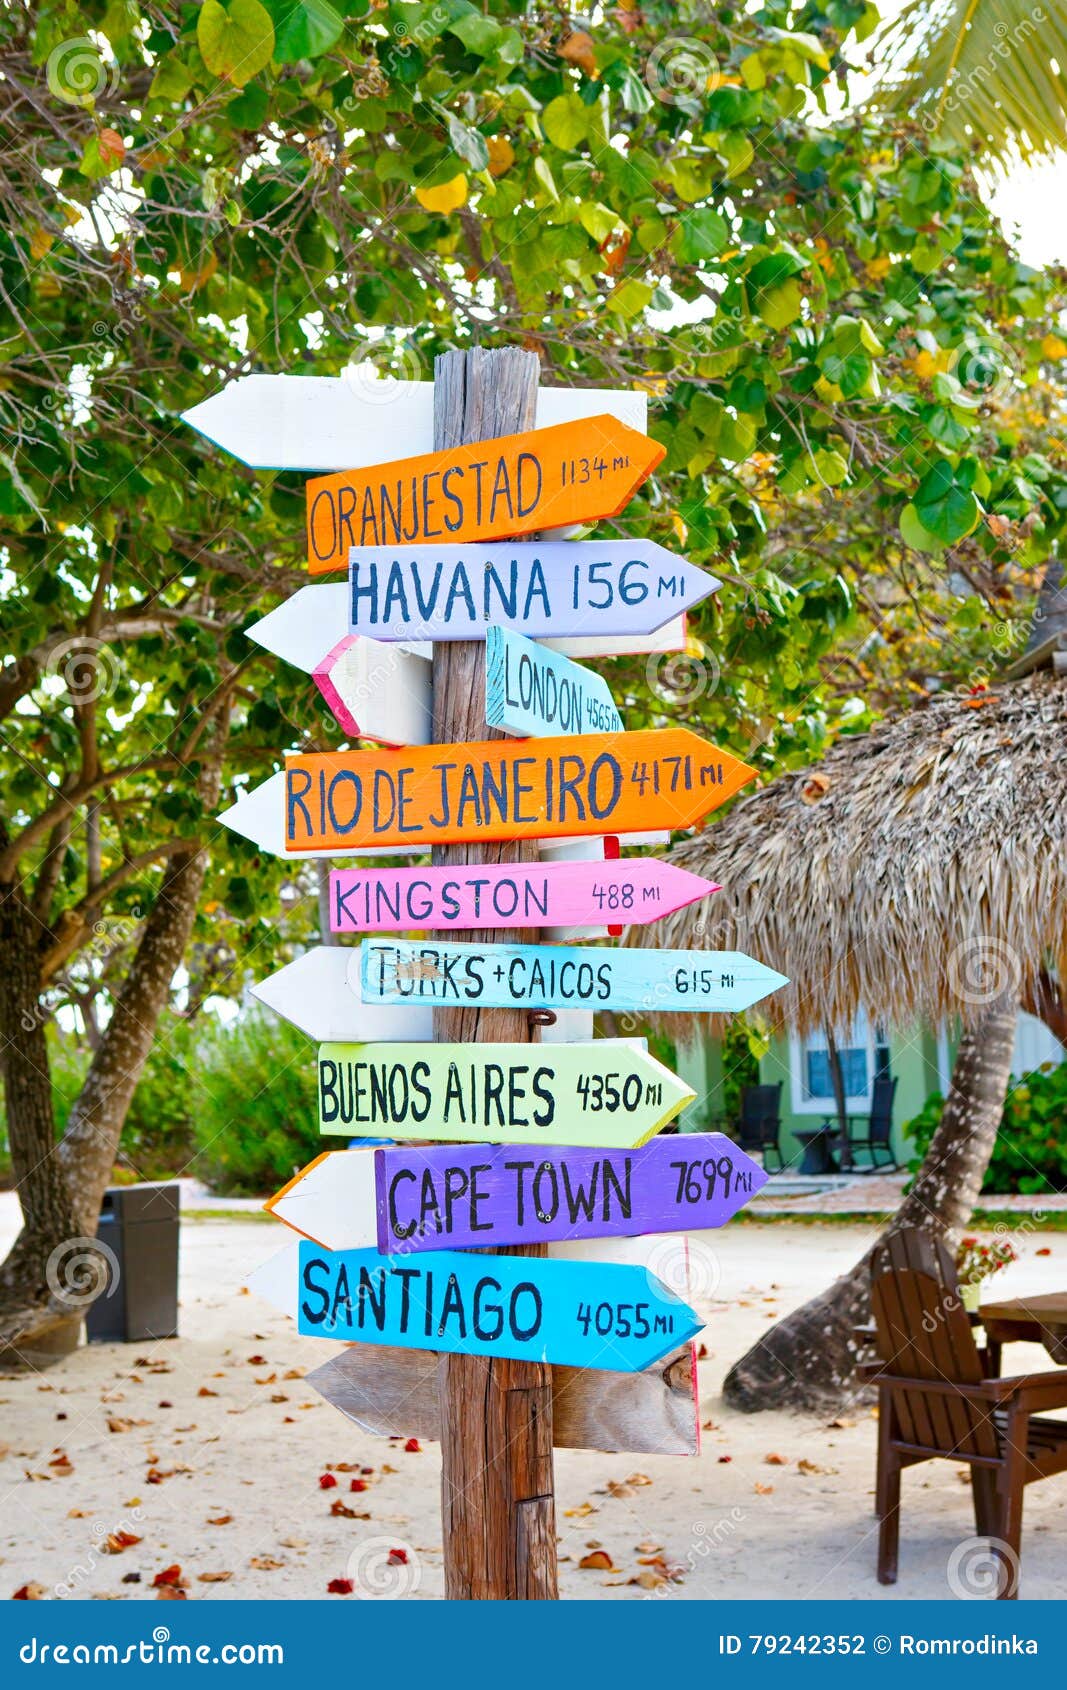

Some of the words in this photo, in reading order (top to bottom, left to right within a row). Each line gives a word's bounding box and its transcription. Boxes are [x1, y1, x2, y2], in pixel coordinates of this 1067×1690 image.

[310, 452, 543, 561] ORANJESTAD
[562, 456, 608, 487] 1134
[613, 455, 629, 472] MI
[352, 558, 552, 626] HAVANA
[572, 560, 649, 610] 156
[658, 575, 685, 598] MI
[505, 643, 583, 735] LONDON
[586, 696, 611, 732] 4565
[287, 768, 363, 841] RIO
[373, 768, 423, 833] DE
[429, 752, 624, 828] JANEIRO
[630, 754, 693, 796] 4171
[700, 764, 724, 786] MI
[336, 878, 549, 927] KINGSTON
[591, 883, 635, 911] 488
[642, 887, 660, 903] MI
[675, 968, 712, 994] 615
[721, 974, 734, 988] MI
[320, 1059, 431, 1124] BUENOS
[443, 1061, 556, 1127] AIRES
[576, 1073, 643, 1113] 4350
[645, 1083, 662, 1106] MI
[389, 1167, 493, 1240] CAPE
[505, 1157, 633, 1227] TOWN
[670, 1156, 734, 1205] 7699
[735, 1171, 752, 1194] MI
[302, 1258, 542, 1342] SANTIAGO
[576, 1302, 650, 1338] 4055
[653, 1315, 674, 1335] MI
